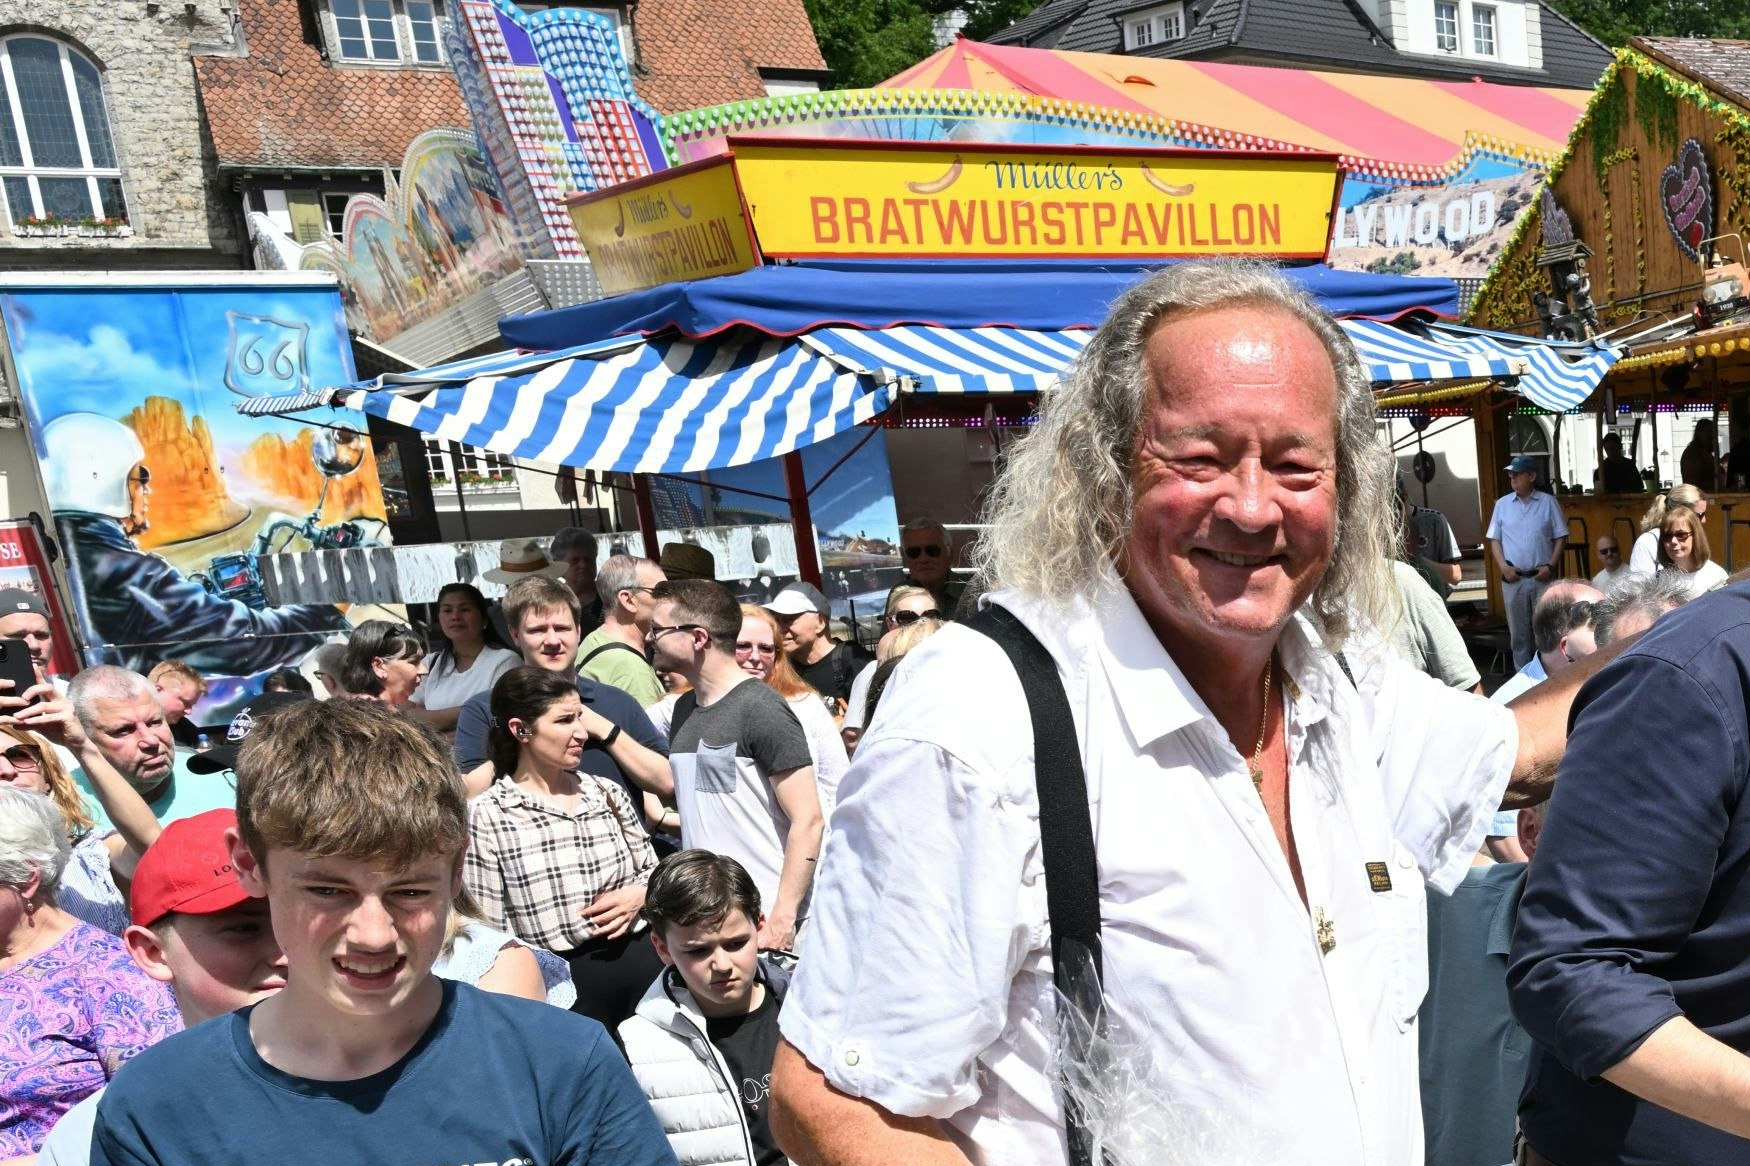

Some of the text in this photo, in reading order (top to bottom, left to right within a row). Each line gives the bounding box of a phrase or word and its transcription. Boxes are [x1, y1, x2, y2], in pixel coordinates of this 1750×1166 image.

[809, 196, 1282, 246] BRATWURSTPAVILLON
[1331, 190, 1496, 249] LYWOOD
[597, 216, 739, 278] BRATWURSTPAVILLON
[239, 335, 295, 381] 66
